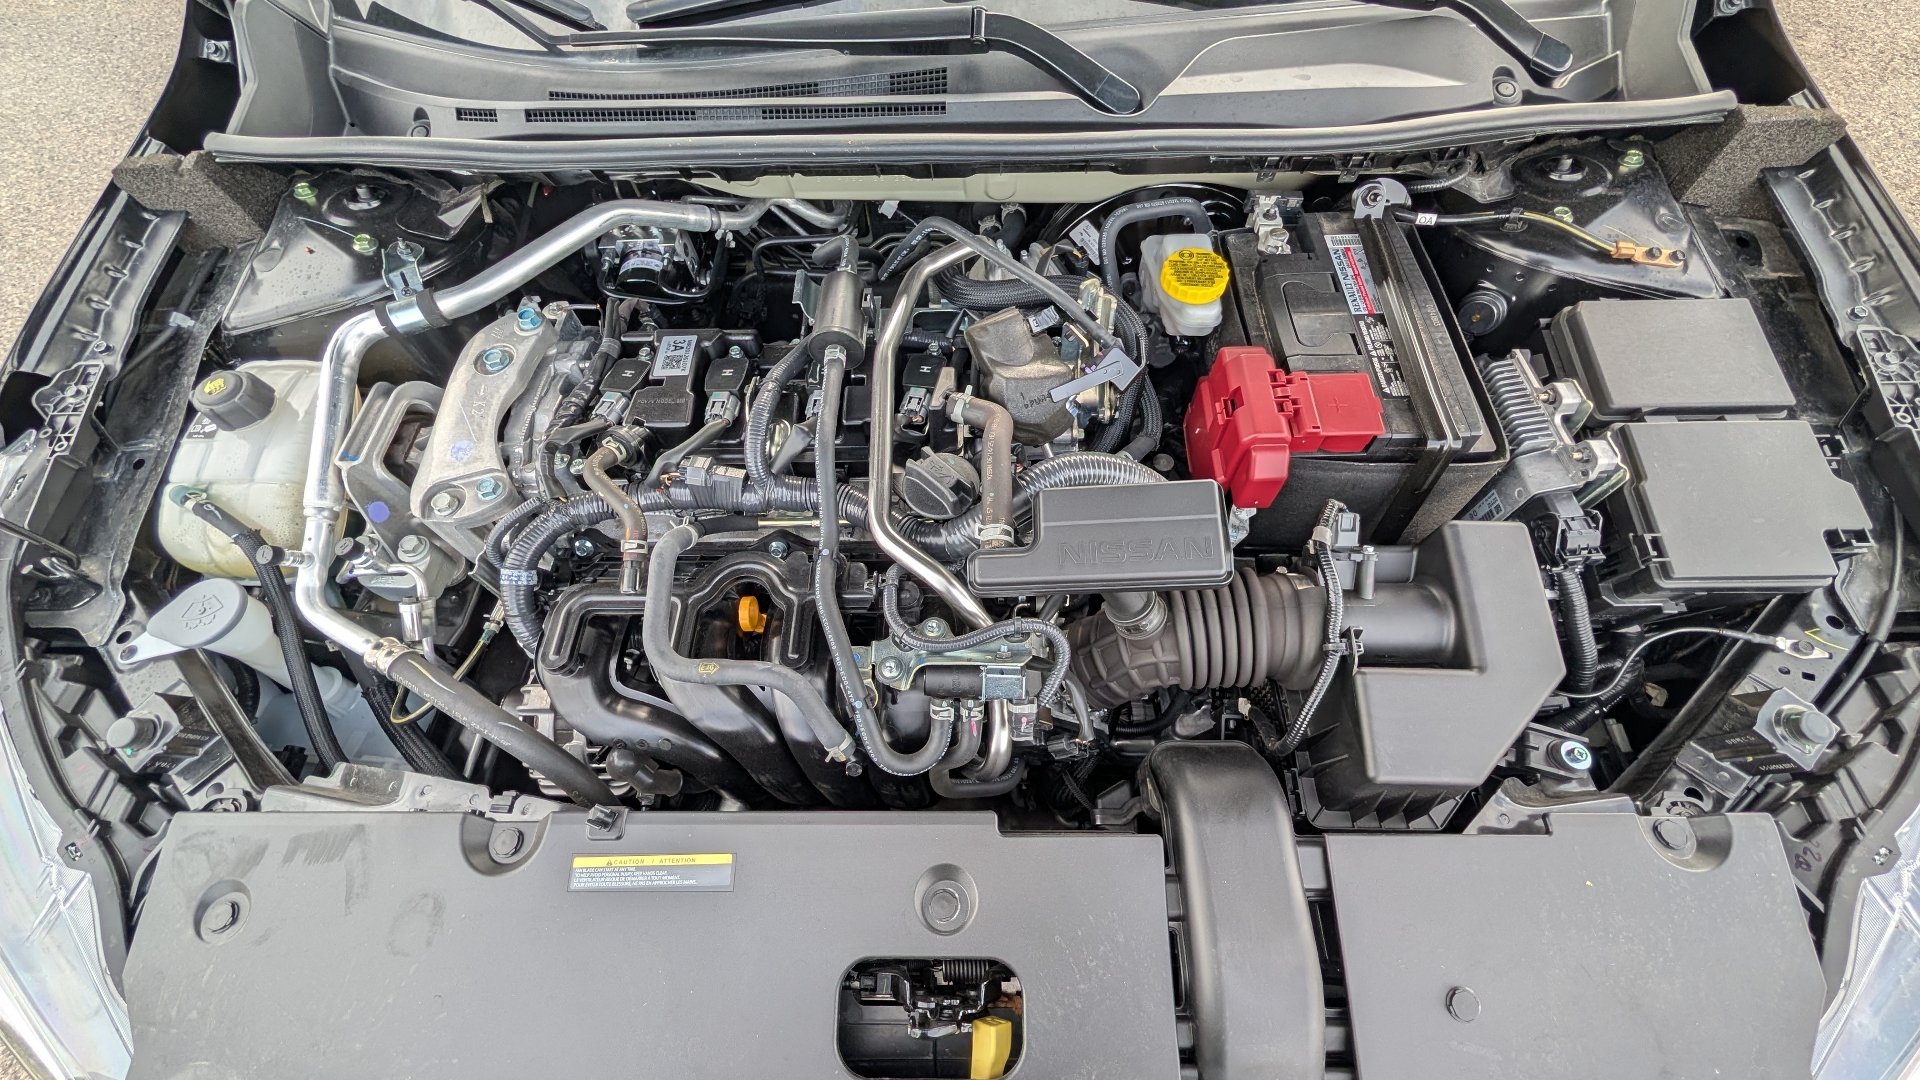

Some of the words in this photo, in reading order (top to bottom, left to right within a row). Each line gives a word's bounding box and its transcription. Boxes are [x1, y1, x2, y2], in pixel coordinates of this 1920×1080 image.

[1332, 248, 1350, 281] NISSAN
[1344, 281, 1362, 313] RENAULT
[670, 339, 686, 353] 3A
[1058, 536, 1215, 565] NISSAN
